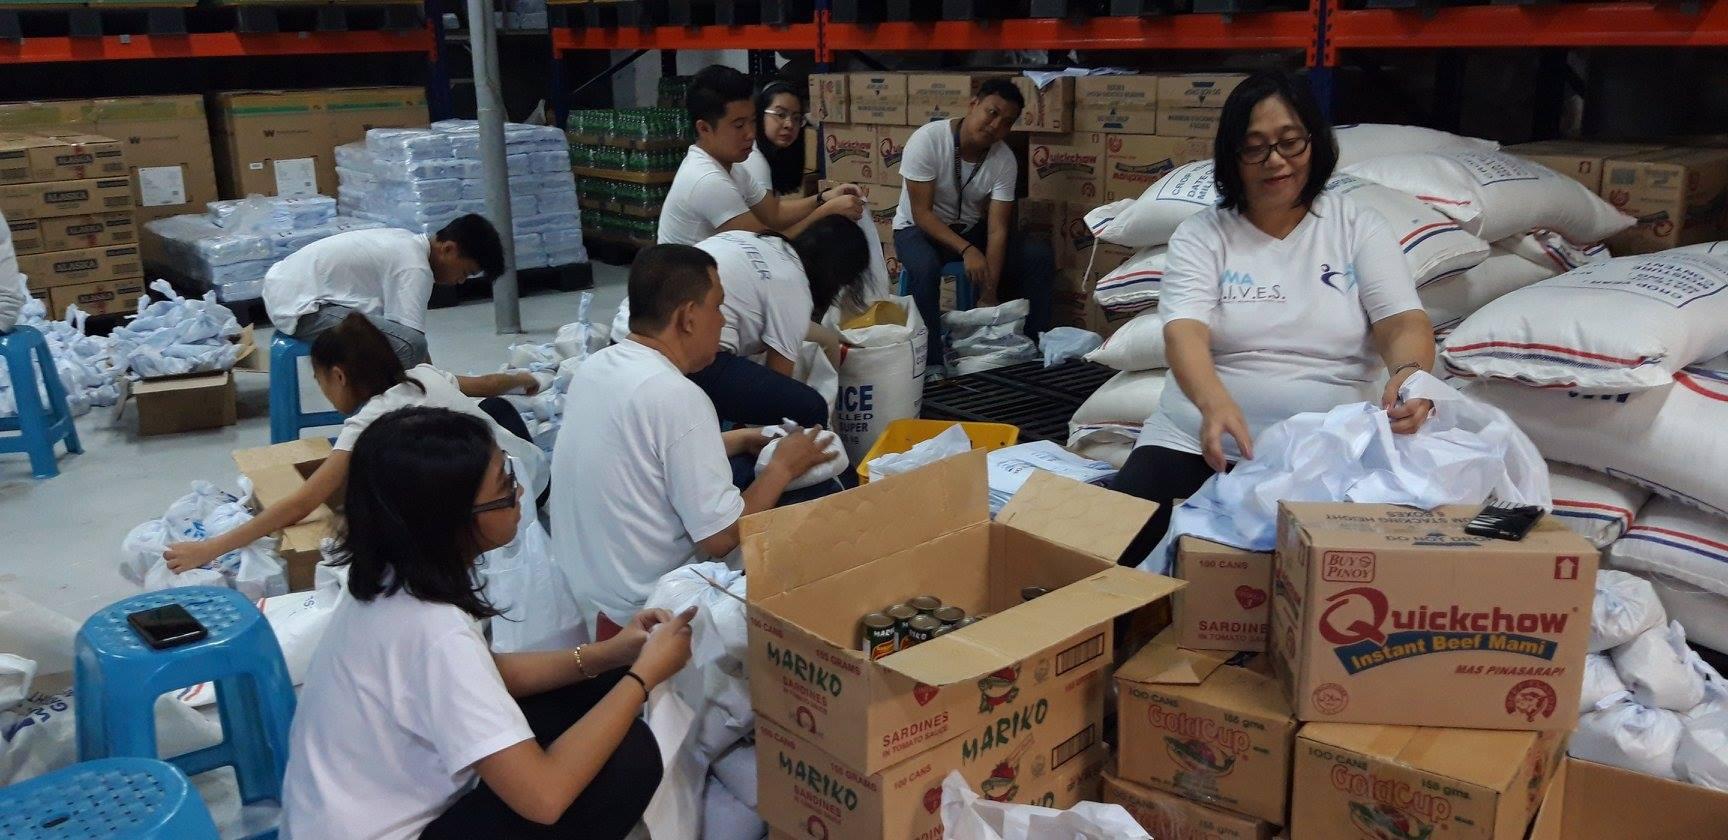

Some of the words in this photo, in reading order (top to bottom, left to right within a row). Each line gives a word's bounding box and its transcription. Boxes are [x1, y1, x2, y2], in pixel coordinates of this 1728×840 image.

[46, 191, 87, 202] ALASKA
[54, 259, 97, 273] ALASKA
[837, 385, 874, 412] ICE
[1326, 514, 1375, 522] HEIGHT
[1329, 555, 1357, 567] BUY
[1326, 566, 1370, 580] PINOY
[1318, 586, 1569, 646] Quickchow
[1199, 620, 1270, 634] SARDINE
[1351, 639, 1426, 668] Instant
[1432, 633, 1483, 652] Beef
[1488, 634, 1546, 655] Mami
[766, 641, 842, 697] MARIKO
[830, 655, 861, 676] GRAMS
[1455, 664, 1484, 676] MAS
[1486, 665, 1565, 677] PINASARAP!
[783, 675, 828, 707] SARDINES
[1152, 694, 1179, 707] CANS
[883, 711, 949, 747] SARDINES
[961, 697, 1049, 767] MARIKO
[892, 735, 924, 753] TOMATO
[1335, 754, 1369, 770] CANS
[779, 751, 858, 812] MARIKO
[909, 763, 933, 783] CANS
[794, 785, 842, 818] SARDINES
